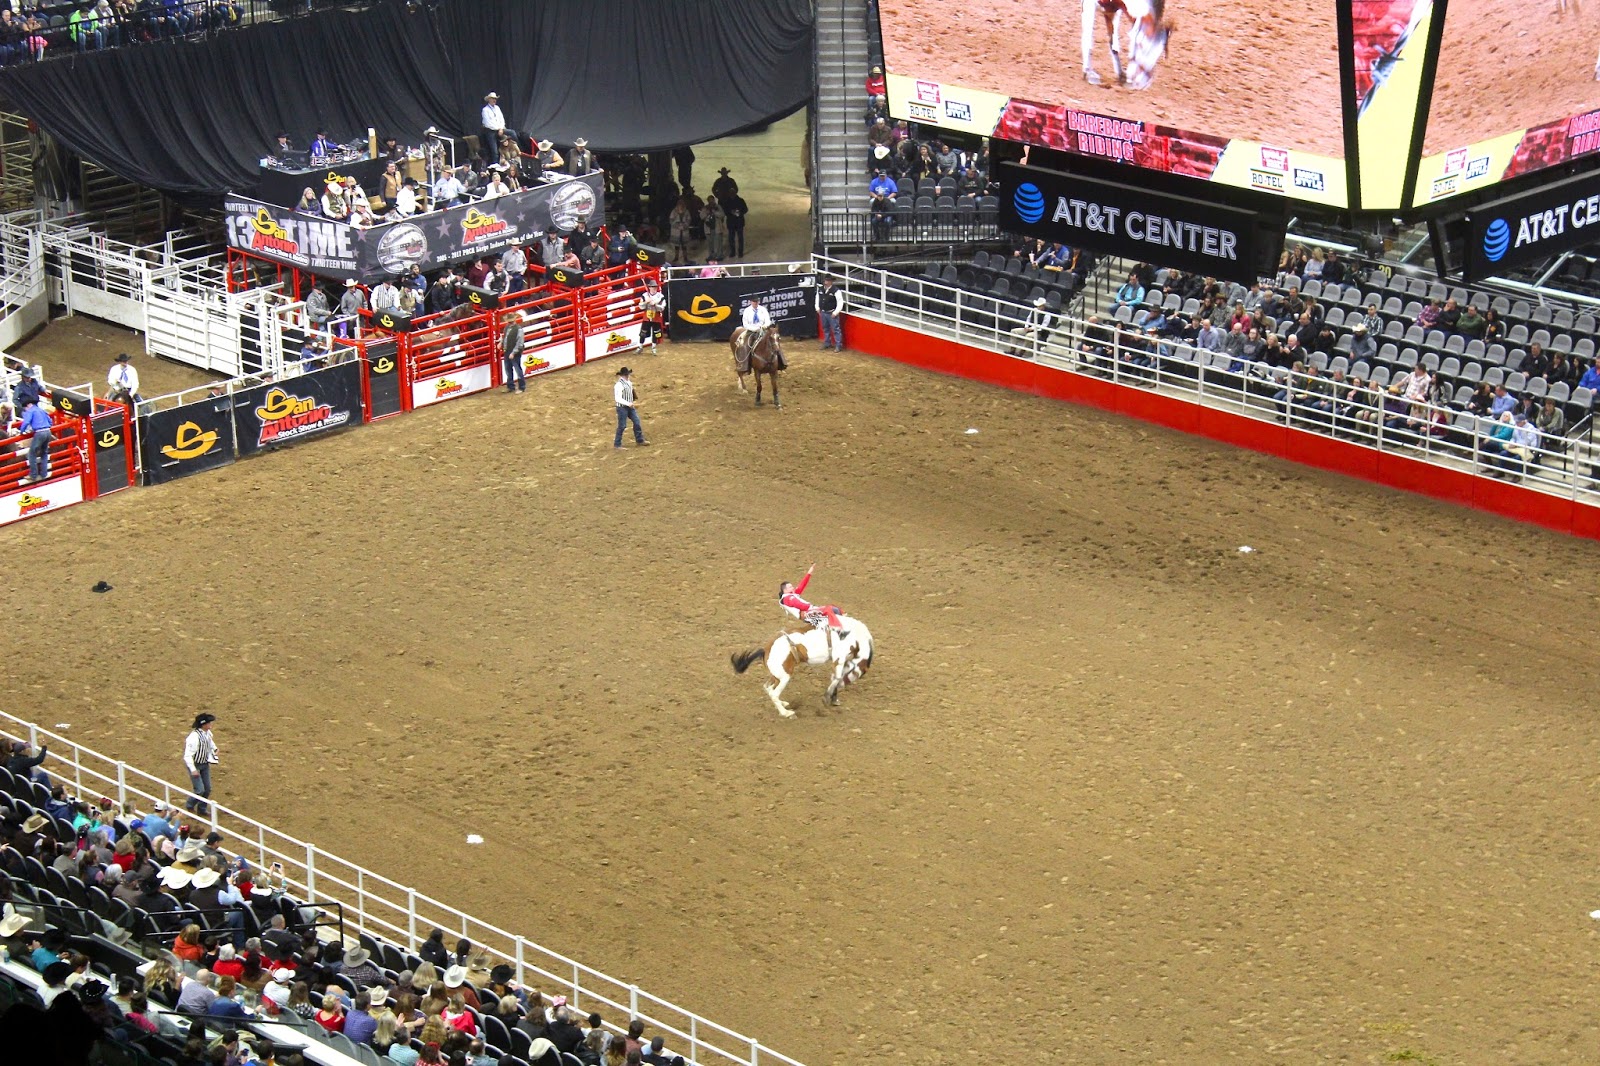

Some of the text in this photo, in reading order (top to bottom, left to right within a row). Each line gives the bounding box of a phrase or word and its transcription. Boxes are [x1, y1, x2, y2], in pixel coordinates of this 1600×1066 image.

[1068, 110, 1141, 141] BAREBACK
[1568, 111, 1600, 138] BARE
[1078, 133, 1135, 160] RIDING
[251, 207, 287, 239] San
[462, 208, 496, 229] San
[1052, 196, 1237, 260] AT&T CENTER
[1514, 195, 1600, 248] AT&T CE
[225, 215, 253, 249] 13
[280, 218, 354, 258] TIME
[252, 232, 298, 253] Antonio
[463, 221, 507, 244] Antonio
[311, 258, 357, 270] THIRTEEN TIME
[762, 291, 803, 304] ANTONIO
[770, 300, 796, 310] SHOW
[798, 298, 806, 306] &
[257, 388, 313, 420] San
[259, 406, 329, 444] Antonio
[277, 426, 298, 438] Stock
[297, 422, 317, 433] Show
[323, 414, 346, 427] Rodeo
